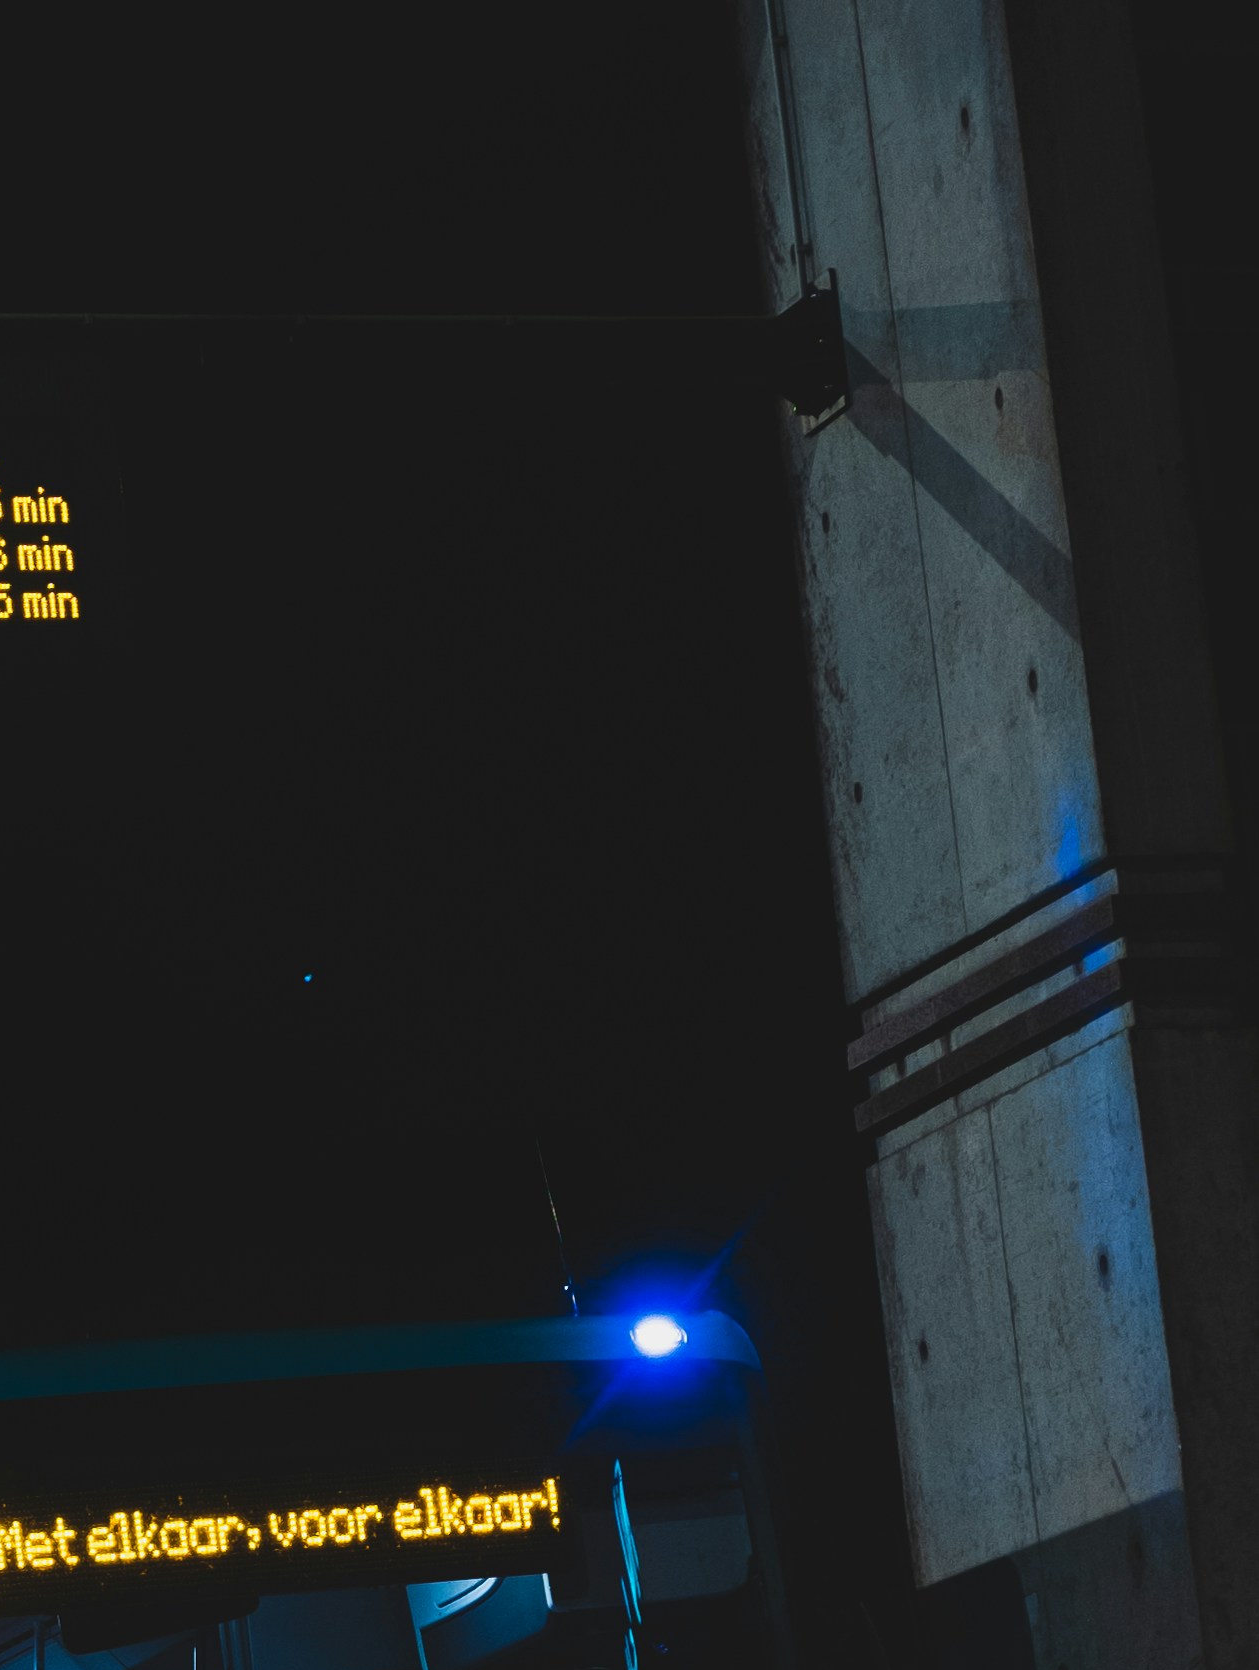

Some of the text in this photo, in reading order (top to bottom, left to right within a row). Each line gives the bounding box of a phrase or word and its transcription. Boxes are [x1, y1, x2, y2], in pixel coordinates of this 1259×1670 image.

[12, 487, 69, 523] min
[17, 535, 74, 571] min
[22, 583, 79, 619] min
[87, 1511, 261, 1562] elkaar,
[269, 1505, 383, 1548] voor
[393, 1479, 559, 1539] elkaar!
